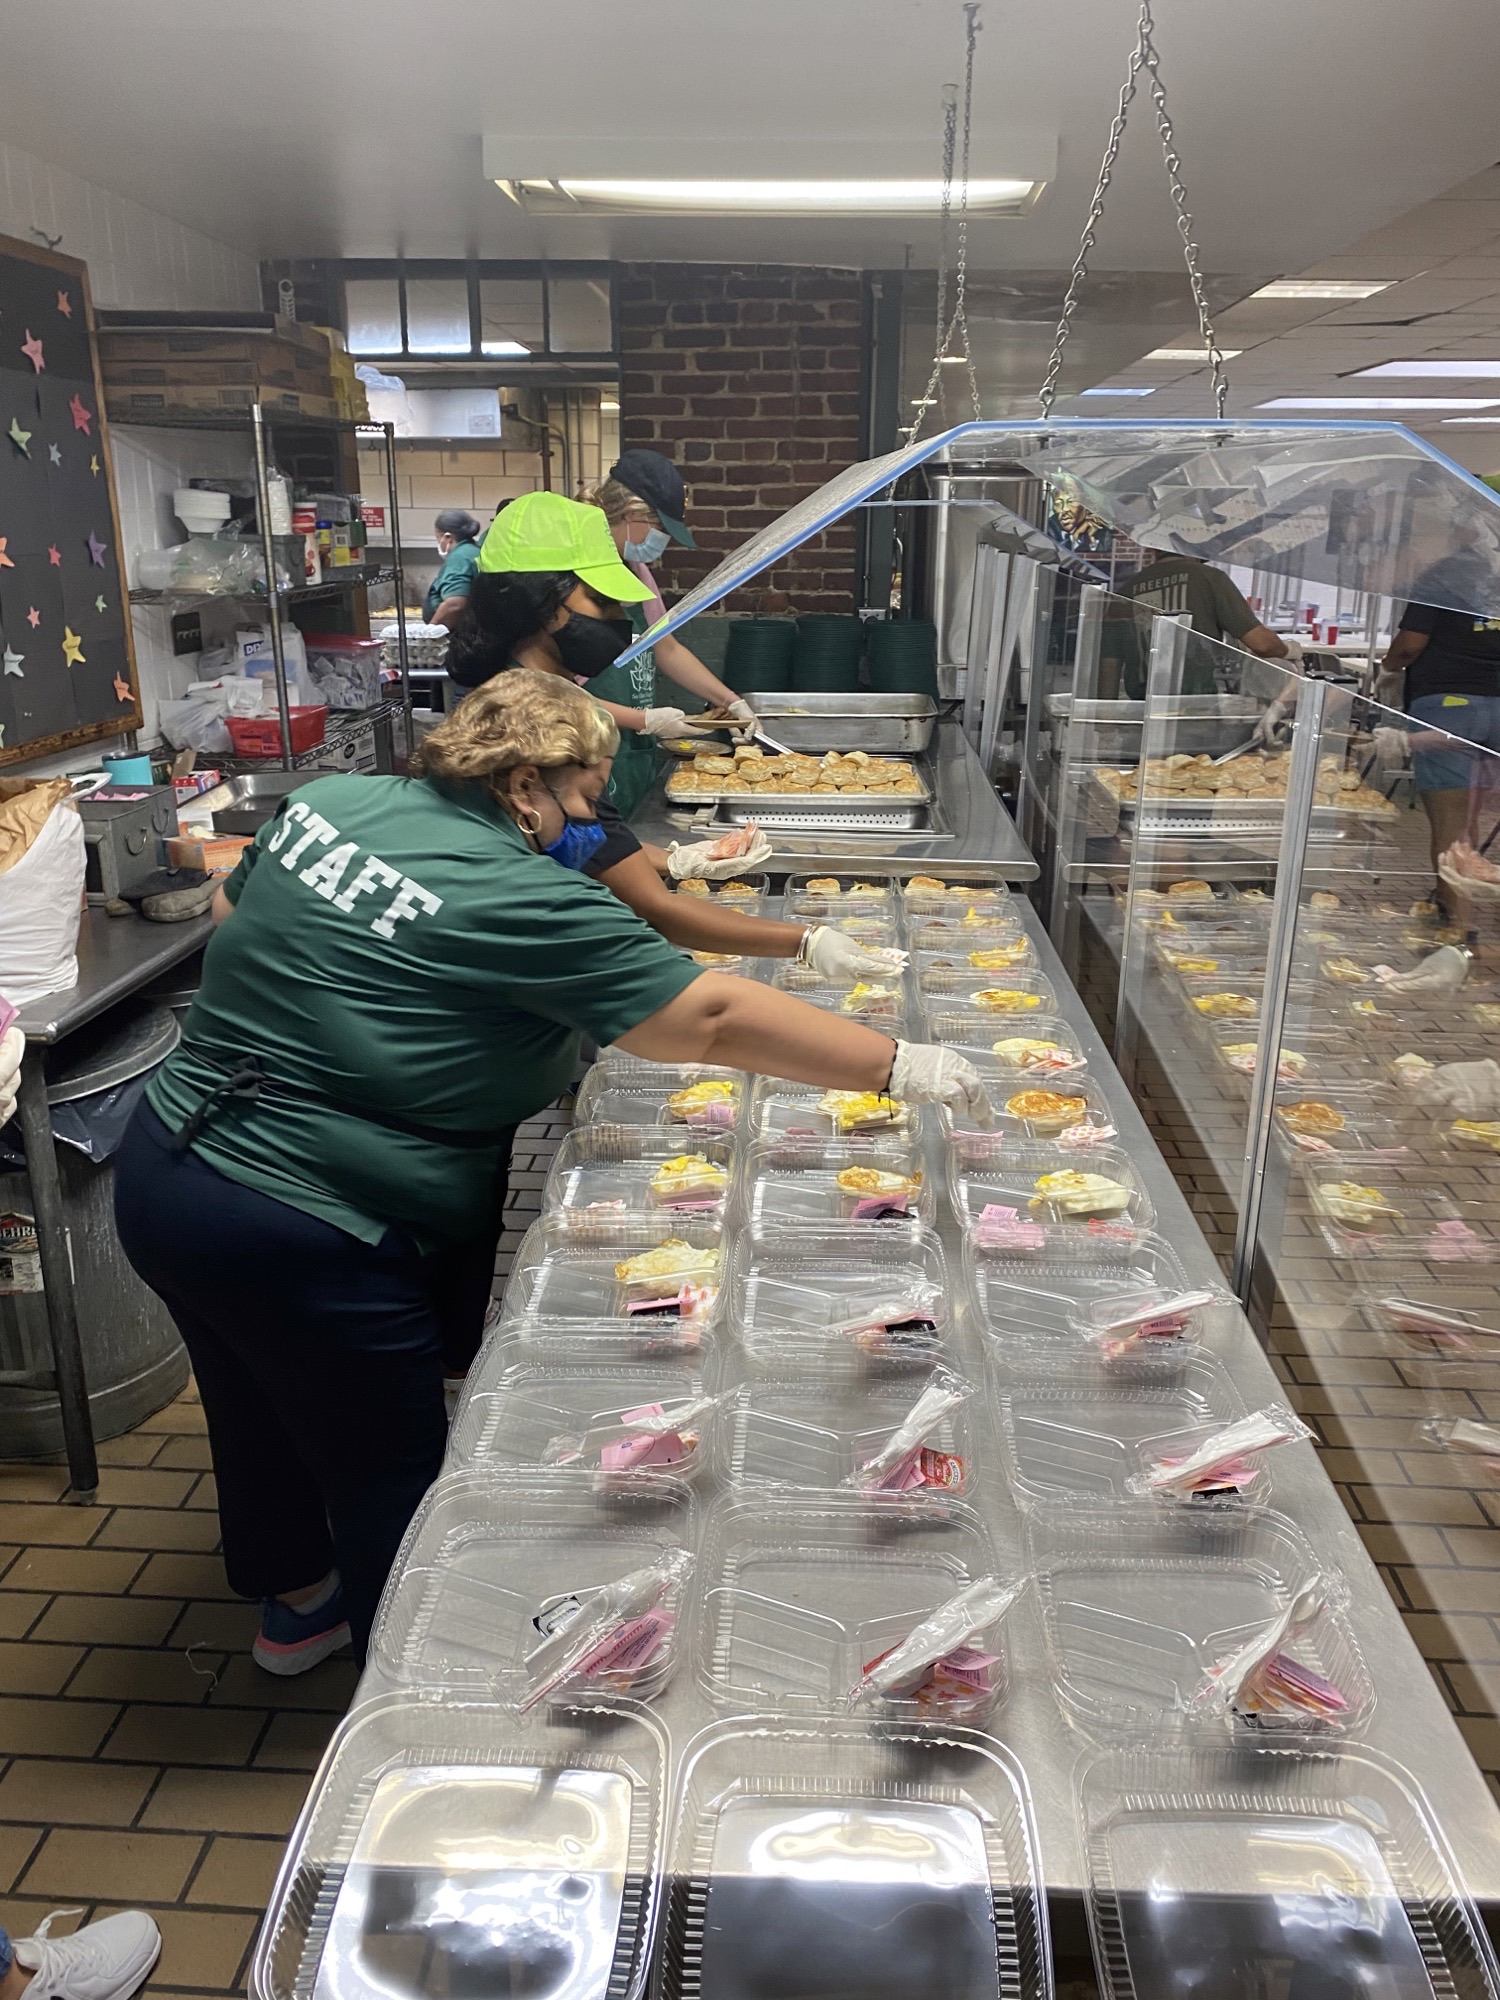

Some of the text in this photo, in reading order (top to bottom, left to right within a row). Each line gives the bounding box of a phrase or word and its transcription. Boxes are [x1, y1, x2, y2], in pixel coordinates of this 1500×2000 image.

[1132, 573, 1189, 595] FREEDOM
[268, 802, 444, 939] STAFF
[0, 1225, 36, 1239] EHR
